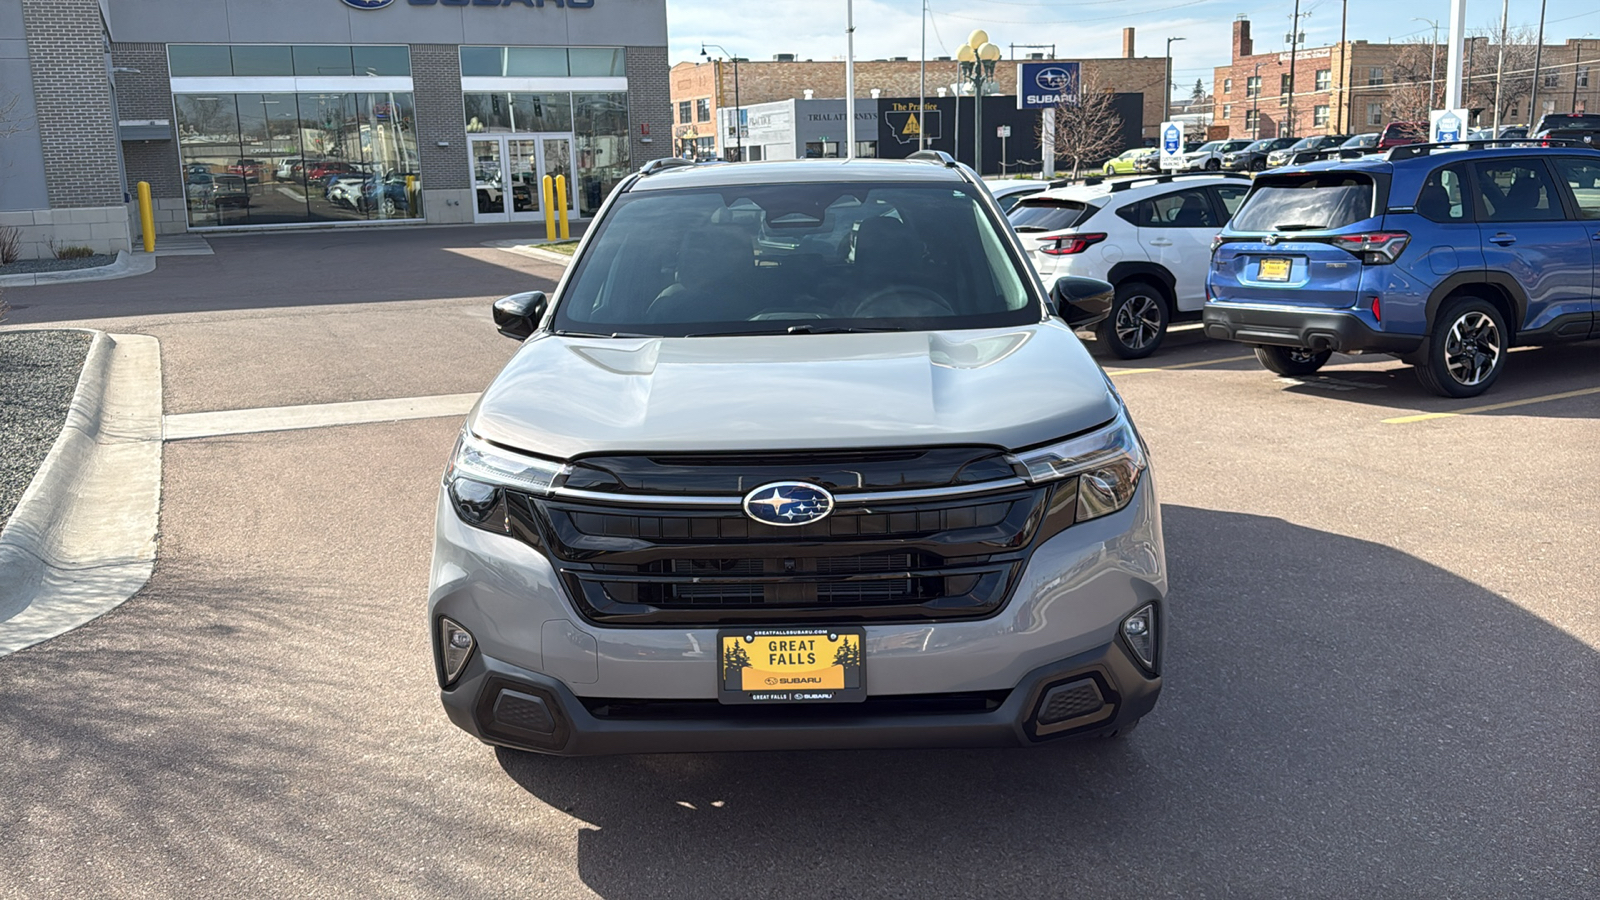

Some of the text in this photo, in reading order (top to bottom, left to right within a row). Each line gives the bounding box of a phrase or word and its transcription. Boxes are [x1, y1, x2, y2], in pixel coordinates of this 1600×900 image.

[1026, 94, 1076, 104] SUBARU
[892, 102, 938, 111] The Pratice
[808, 112, 878, 121] TRIAL ATTRNEYS
[768, 640, 816, 652] GREAT
[769, 652, 816, 665] FALLS
